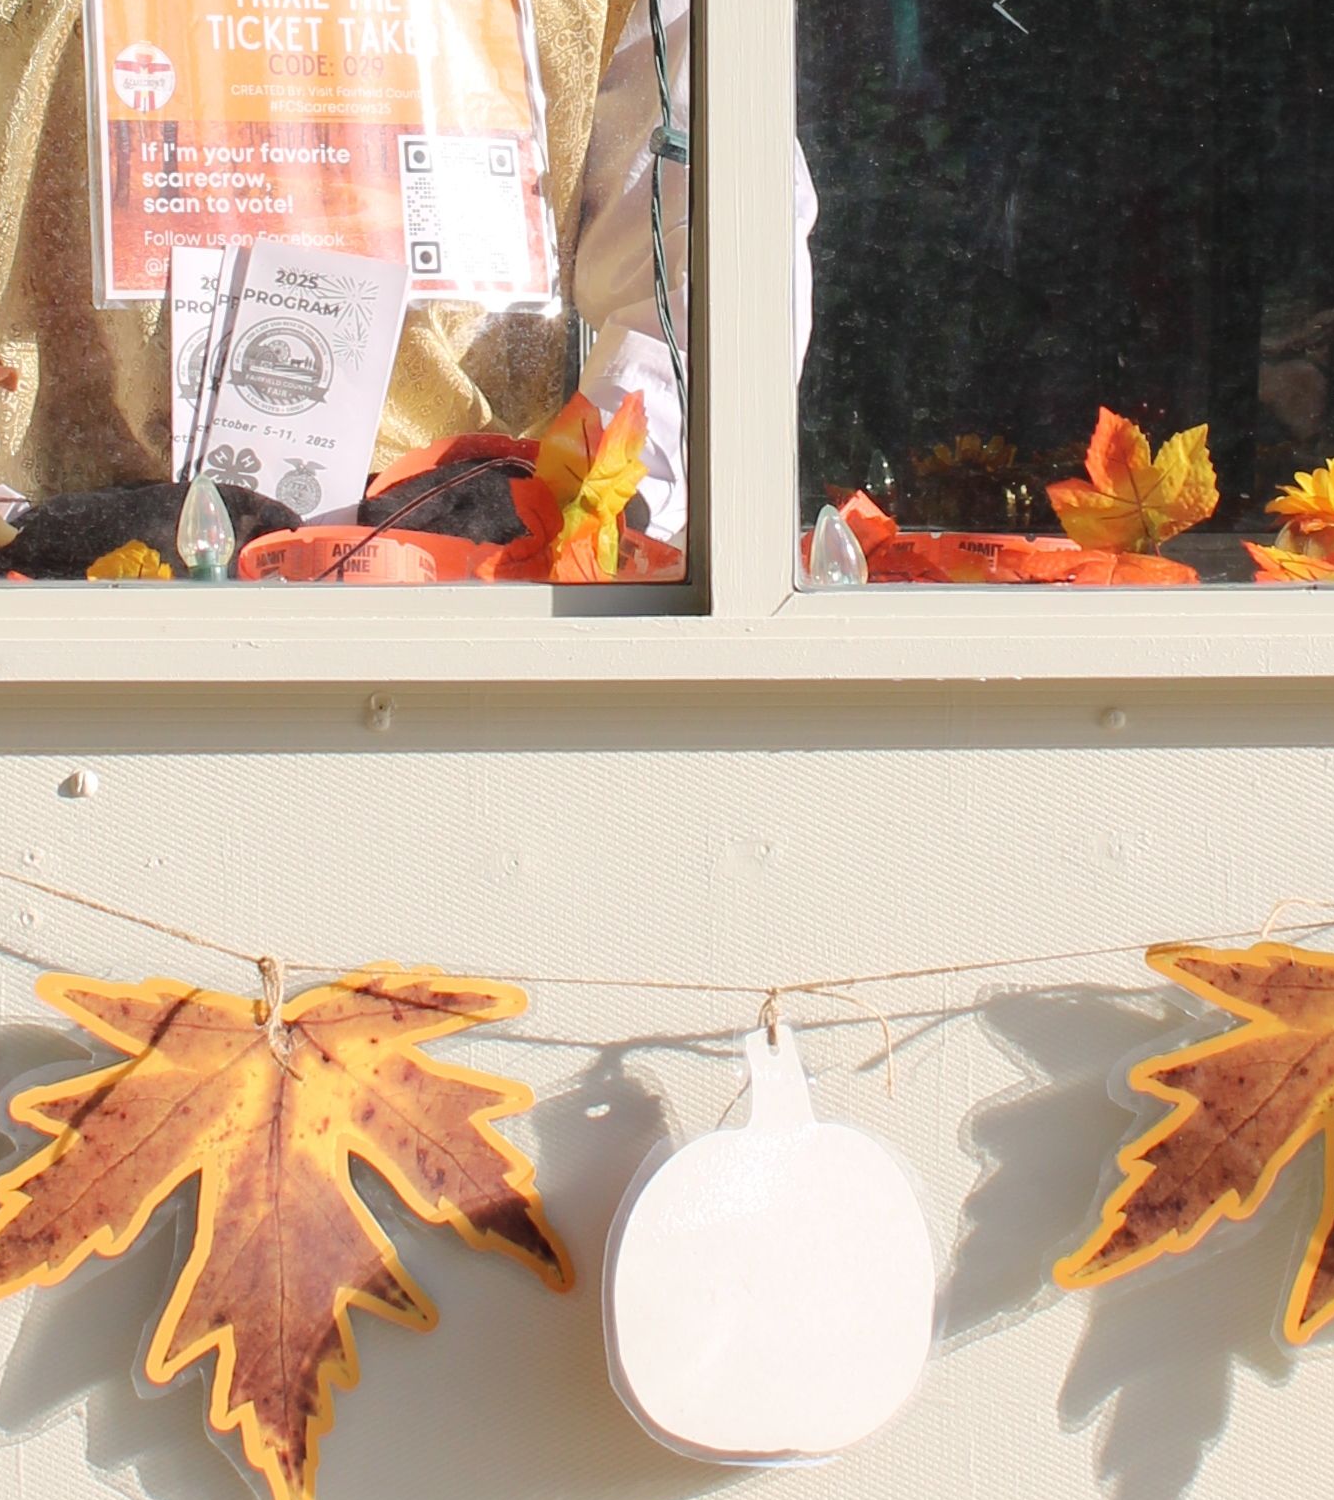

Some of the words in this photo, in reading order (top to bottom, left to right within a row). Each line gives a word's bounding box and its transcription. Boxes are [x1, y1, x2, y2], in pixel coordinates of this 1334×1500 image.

[206, 14, 323, 53] TICKET
[269, 54, 335, 77] CODE:
[343, 56, 385, 79] 029
[230, 84, 284, 97] CREATED
[308, 86, 333, 98] Visit
[336, 87, 383, 99] Fairfield
[385, 87, 424, 100] Count
[141, 142, 157, 162] If
[163, 143, 197, 163] I'm
[204, 146, 254, 166] your
[259, 143, 351, 165] favorite
[142, 170, 272, 192] scarecrow,
[143, 196, 200, 213] scan
[205, 195, 230, 213] to
[234, 193, 294, 214] vote!
[144, 230, 201, 246] Follow
[206, 233, 226, 246] us
[230, 233, 254, 246] on
[274, 270, 319, 290] 2025
[243, 288, 341, 319] PROGRAM
[266, 386, 289, 398] FAIR
[282, 380, 313, 393] COUNTY
[212, 417, 258, 434] ctober
[263, 426, 297, 444] 5-11,
[305, 434, 337, 450] 2025
